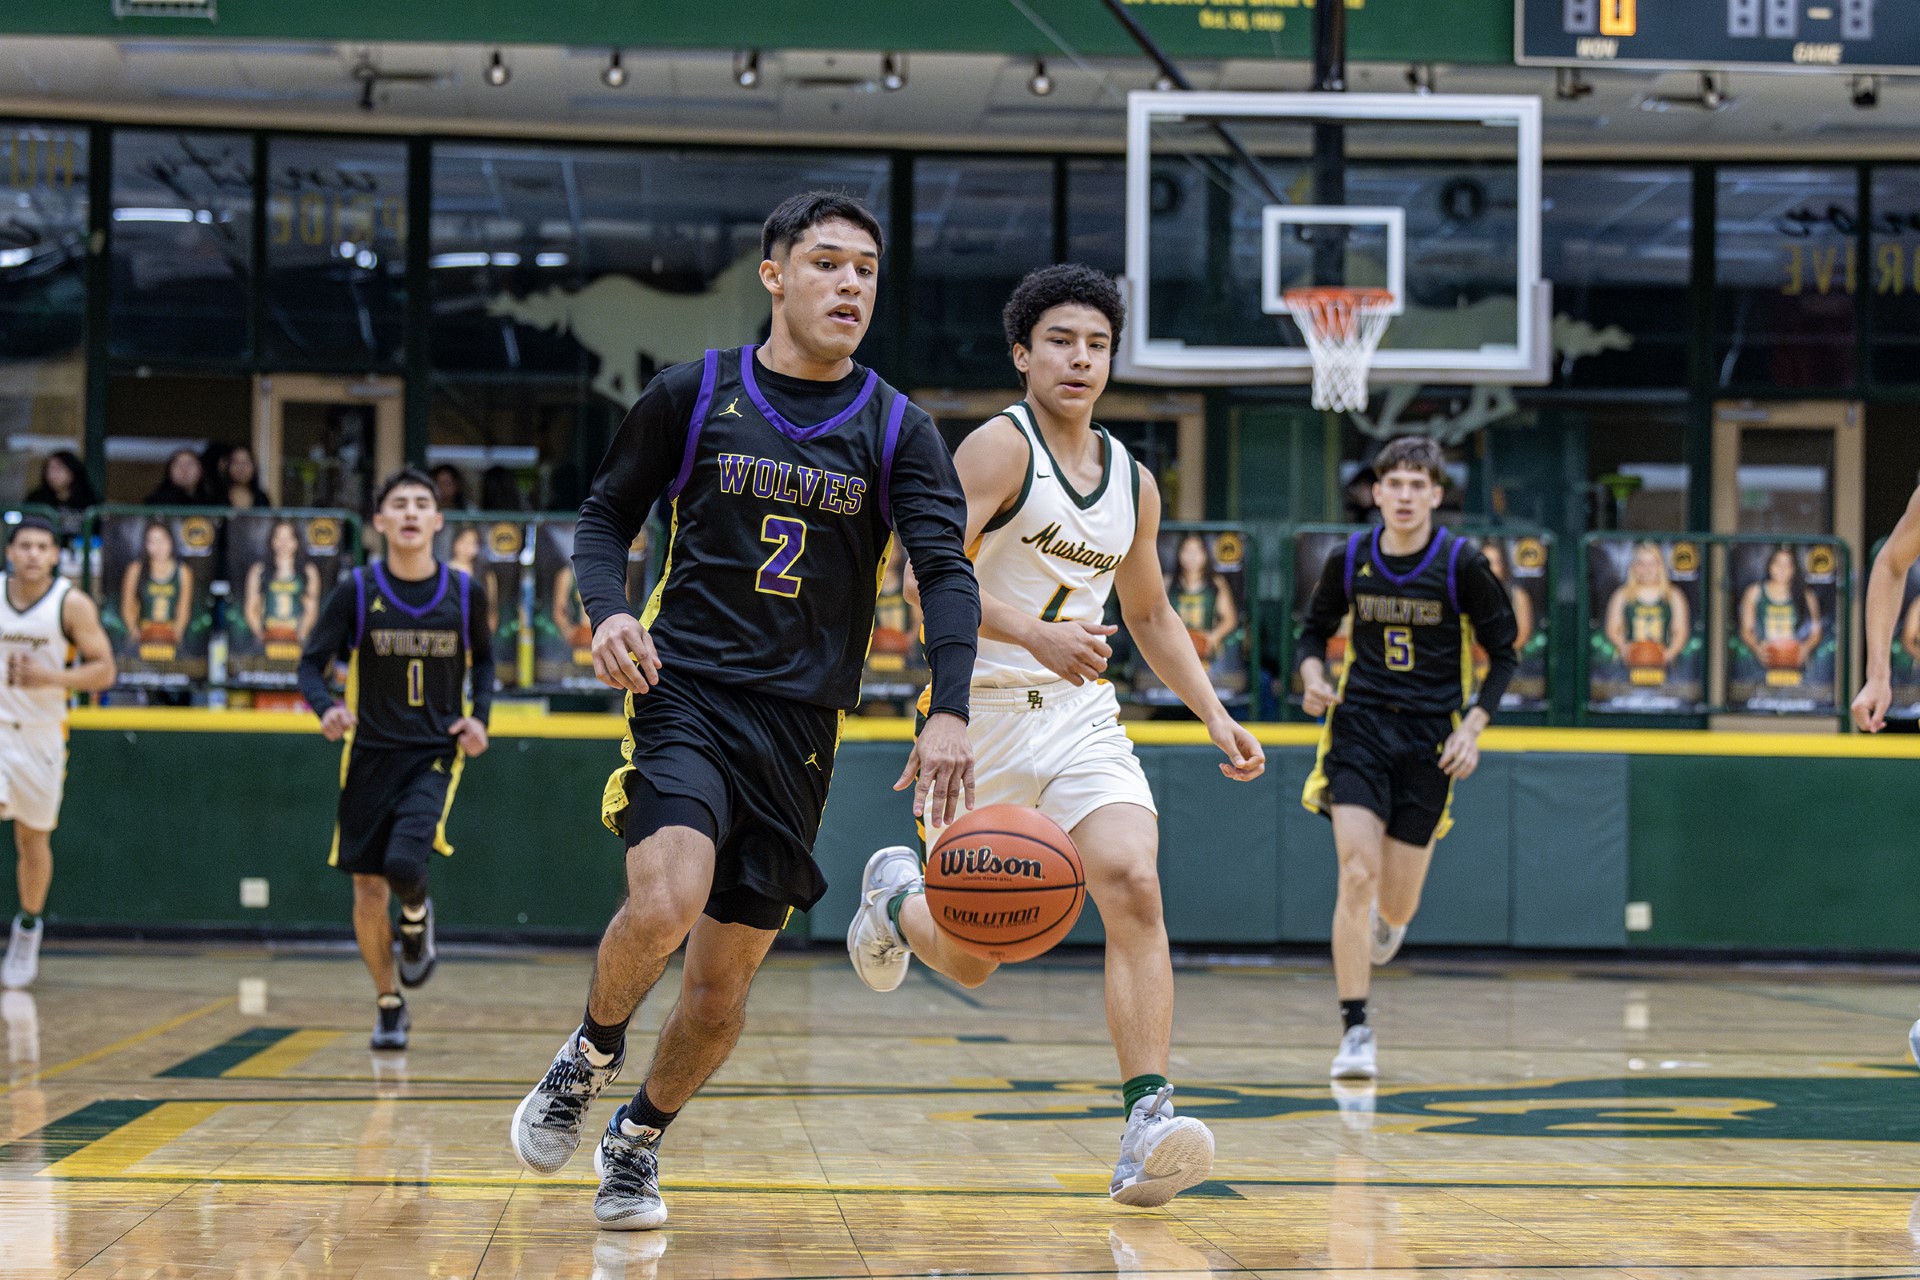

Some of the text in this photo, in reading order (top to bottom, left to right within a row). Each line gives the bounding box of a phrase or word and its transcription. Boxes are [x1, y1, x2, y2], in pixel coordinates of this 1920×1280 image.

[717, 453, 867, 515] WOLVES
[755, 514, 807, 598] 2
[1355, 593, 1443, 626] WOLVES
[370, 628, 458, 657] WOLVES
[1383, 625, 1415, 672] 5
[407, 658, 424, 707] 1
[939, 845, 1043, 881] Wilson
[943, 905, 1041, 926] EVOLUTION
